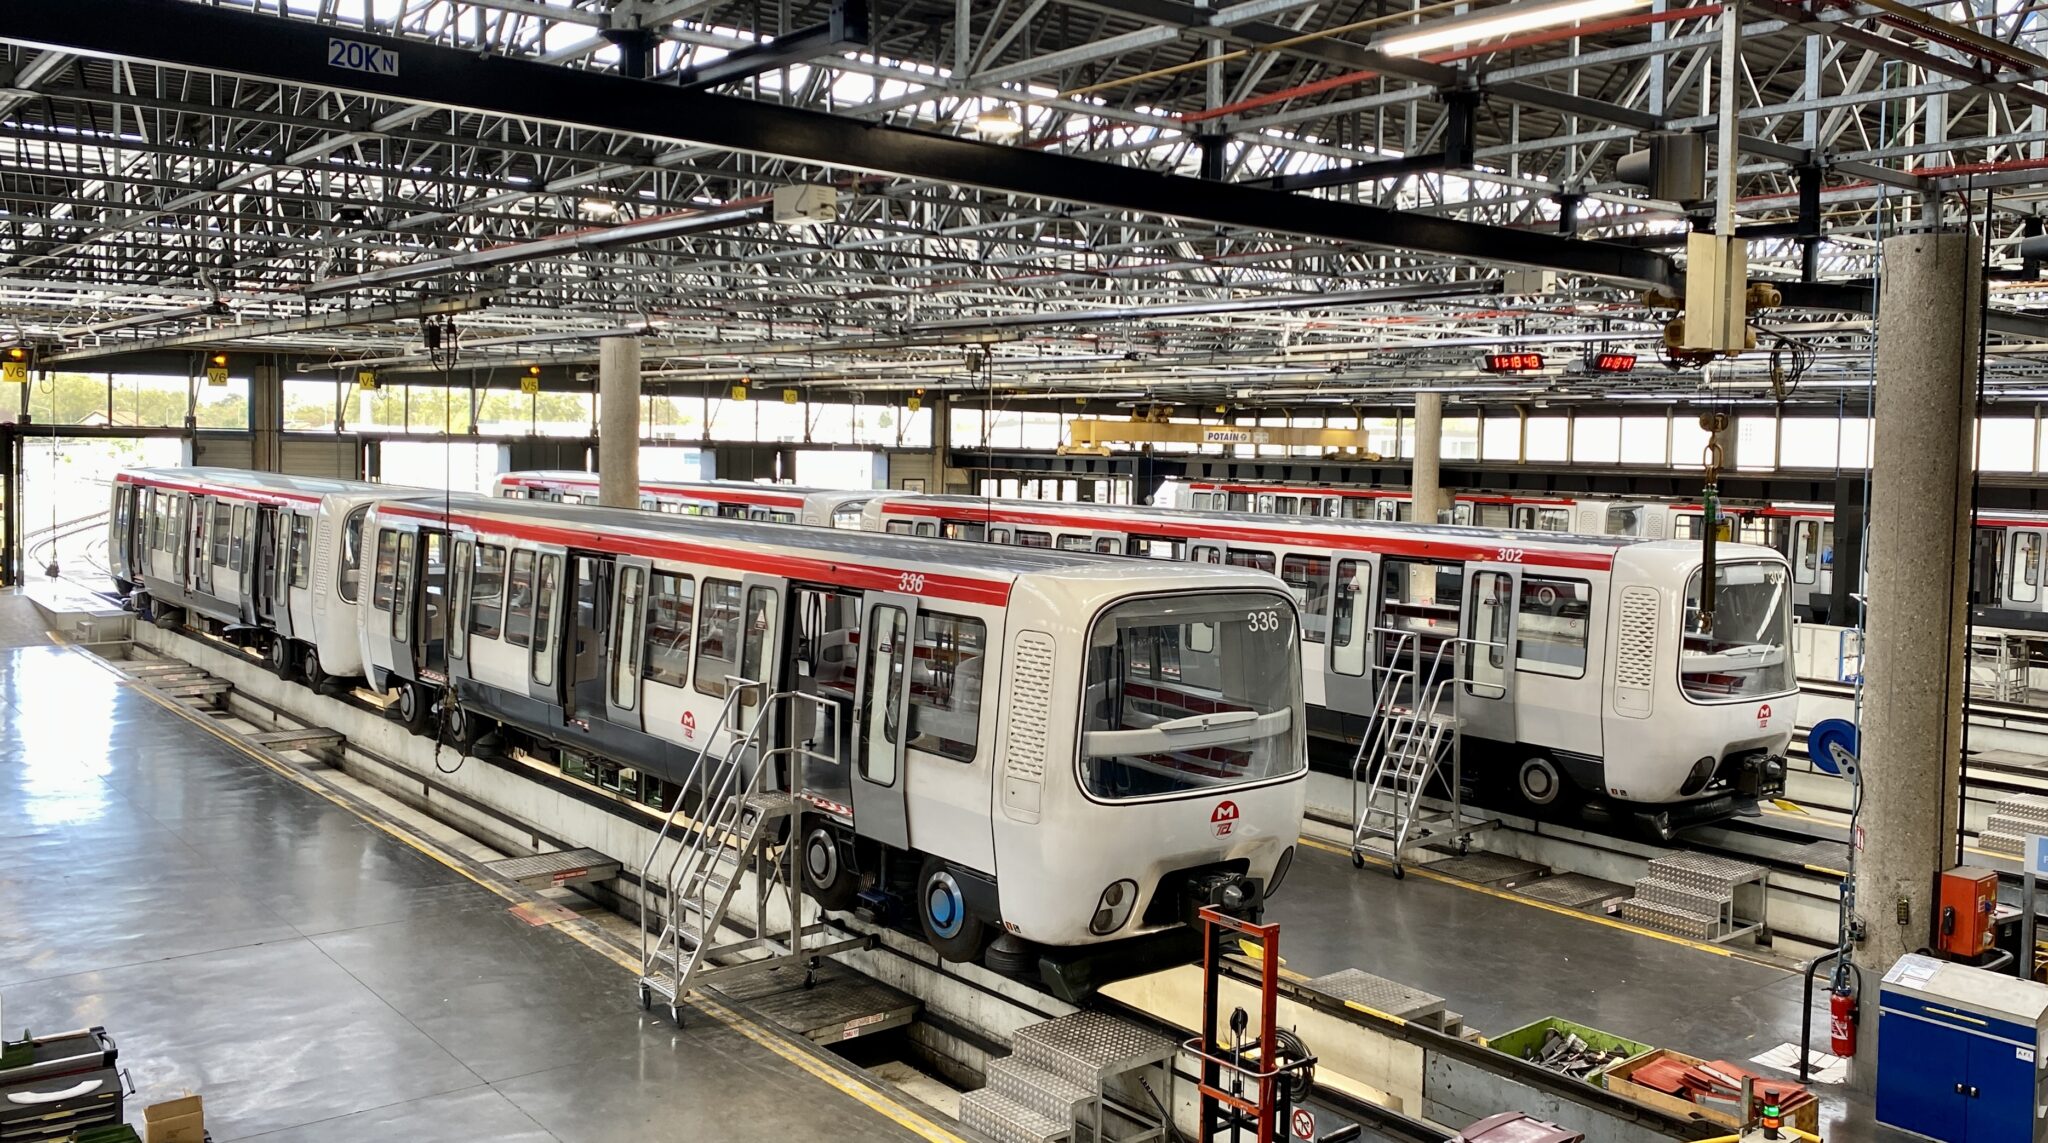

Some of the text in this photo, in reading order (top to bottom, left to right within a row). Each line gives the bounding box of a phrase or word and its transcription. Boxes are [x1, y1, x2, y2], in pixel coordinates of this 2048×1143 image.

[4, 366, 25, 378] V6
[209, 372, 226, 383] V6
[522, 381, 537, 391] V5
[1207, 432, 1239, 441] POTAIN
[1496, 548, 1524, 563] 302
[898, 572, 925, 593] 336
[1247, 610, 1279, 632] 336
[1217, 804, 1235, 820] M
